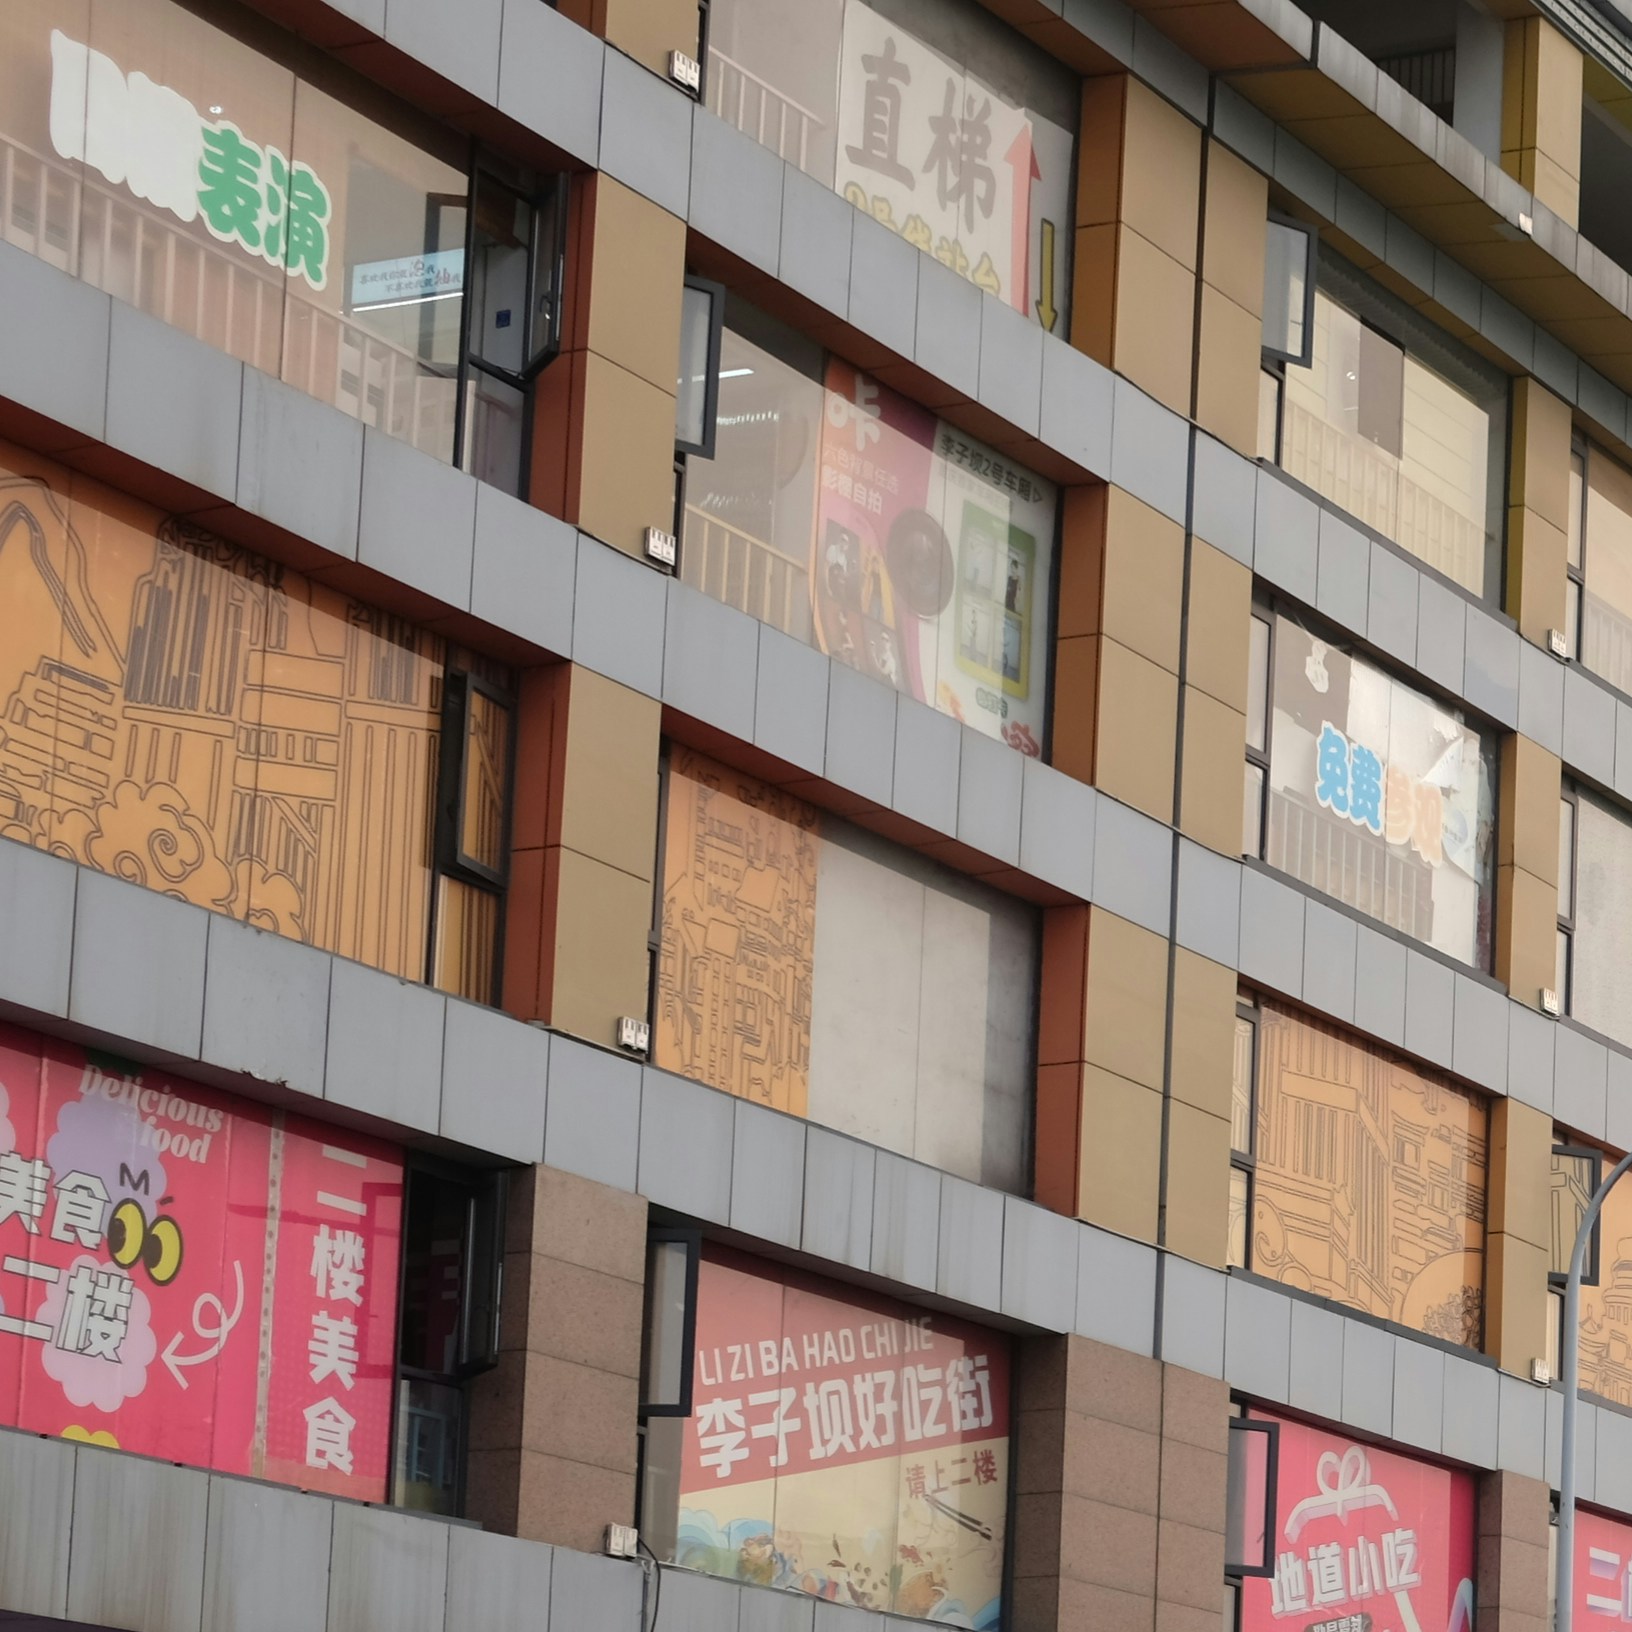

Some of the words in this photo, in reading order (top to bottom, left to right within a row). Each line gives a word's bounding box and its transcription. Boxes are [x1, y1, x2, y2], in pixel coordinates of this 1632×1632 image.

[846, 37, 997, 234] 直梯
[198, 121, 331, 290] 表演
[1315, 722, 1384, 837] 免费
[79, 1064, 224, 1133] Delicious
[137, 1117, 211, 1164] food
[0, 1151, 112, 1250] 美食
[0, 1255, 134, 1364] 二楼
[303, 1143, 367, 1476] 二楼美食
[699, 1347, 723, 1387] LI
[727, 1341, 753, 1382] ZI
[761, 1335, 799, 1377] BA
[803, 1327, 857, 1370] HAO
[860, 1319, 897, 1360] CHI
[903, 1315, 934, 1353] JIE
[696, 1354, 993, 1478] 李子坝好吃街
[905, 1449, 999, 1500] 请上二楼
[1268, 1527, 1420, 1620] 地道小吃
